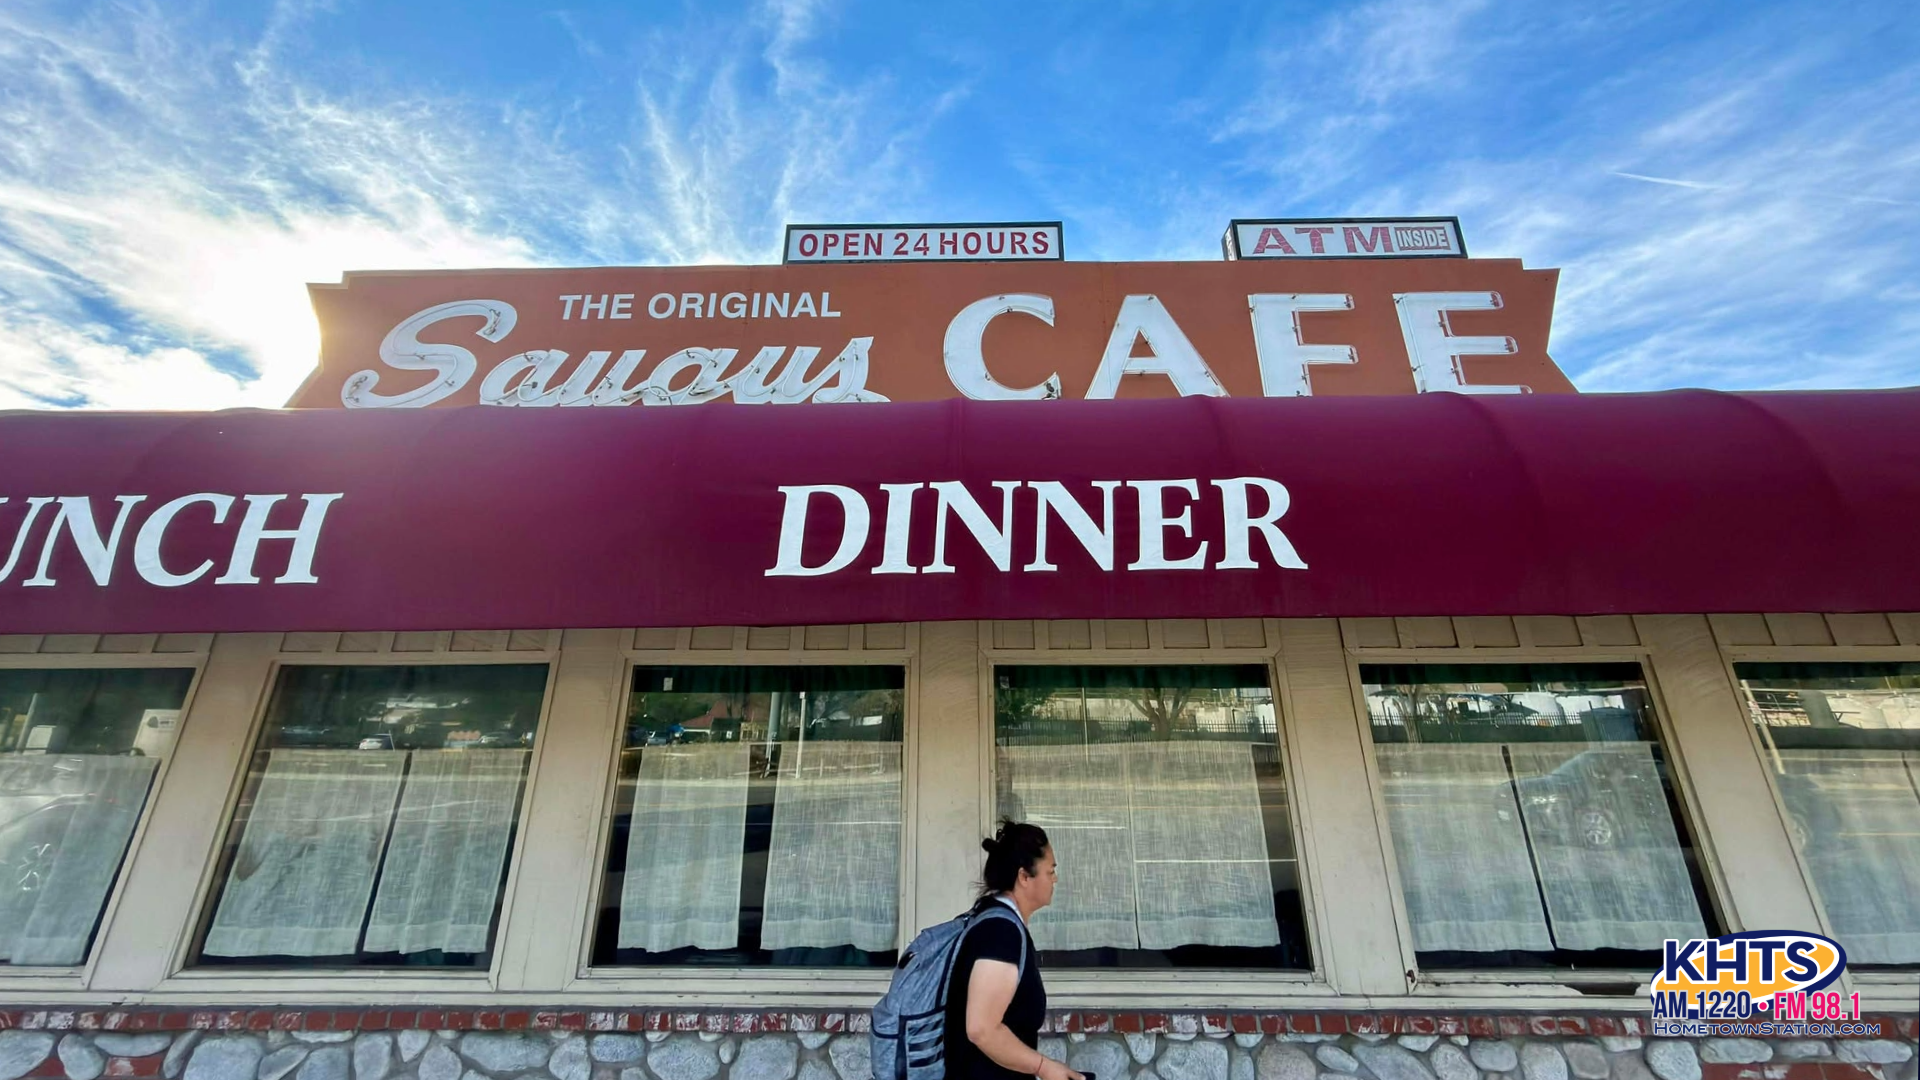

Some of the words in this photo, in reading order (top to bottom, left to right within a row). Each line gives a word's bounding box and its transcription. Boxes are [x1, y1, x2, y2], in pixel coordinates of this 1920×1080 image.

[799, 233, 883, 257] OPEN
[893, 232, 929, 256] 24
[939, 231, 1049, 255] HOURS
[1253, 226, 1395, 255] ATM
[1397, 228, 1447, 247] INSIDE
[559, 293, 635, 320] THE
[647, 291, 841, 319] ORIGINAL
[943, 290, 1532, 400] CAFE
[764, 476, 1309, 577] DINNER
